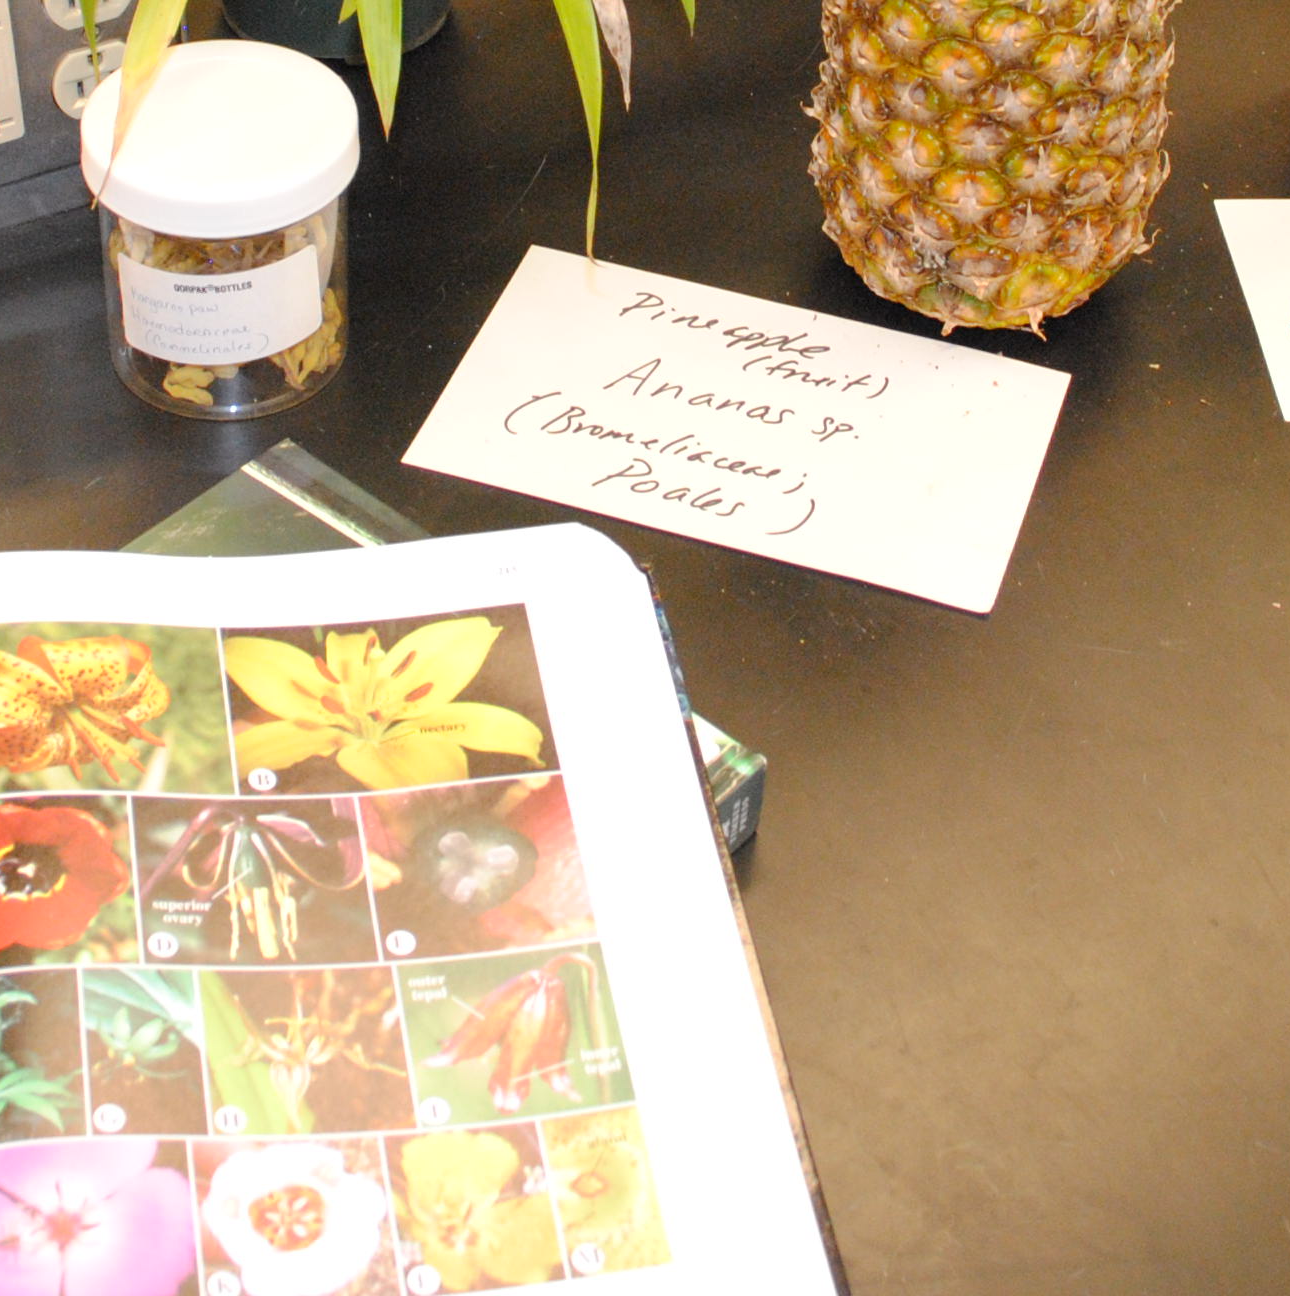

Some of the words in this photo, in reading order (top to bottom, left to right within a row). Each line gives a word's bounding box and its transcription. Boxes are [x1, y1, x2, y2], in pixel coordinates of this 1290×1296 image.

[215, 280, 253, 294] BOTTLES
[618, 292, 831, 359] Pineapple
[742, 356, 889, 399] (fruit)
[603, 358, 795, 425] Ananas
[811, 416, 859, 443] sp.
[418, 722, 467, 735] nectary
[151, 898, 213, 915] superior
[162, 912, 205, 927] ovary
[411, 987, 448, 1003] tepal
